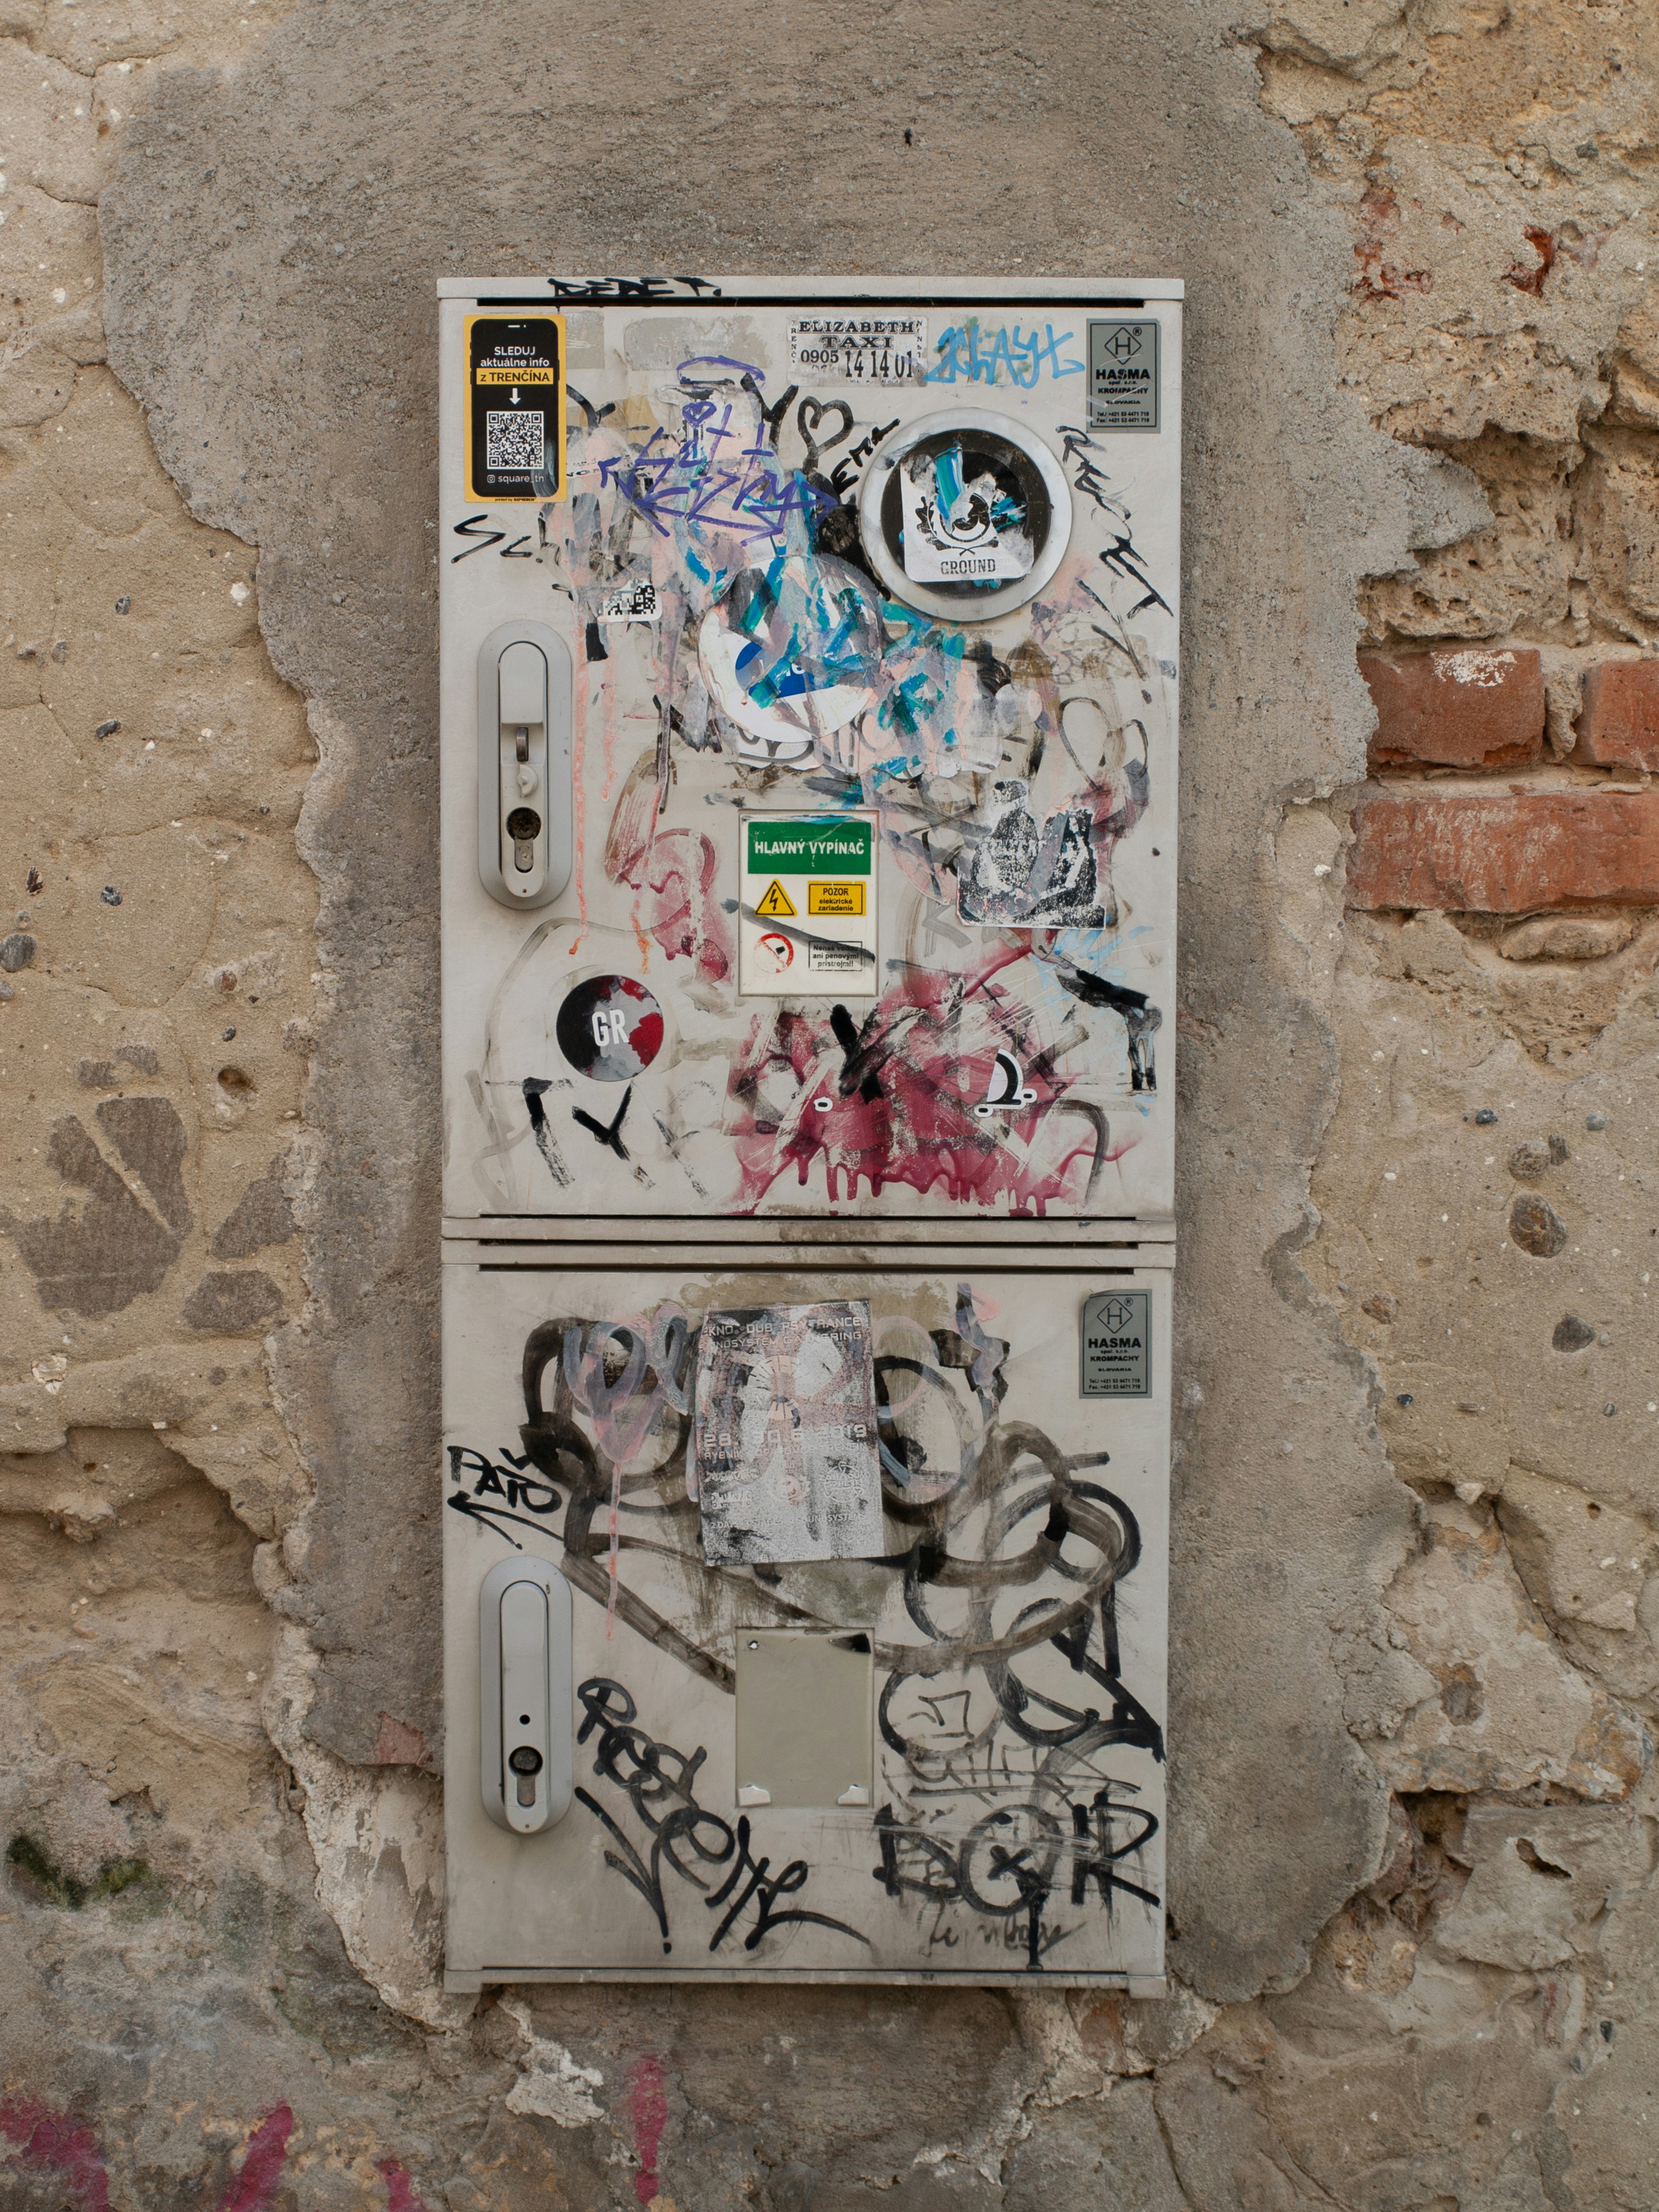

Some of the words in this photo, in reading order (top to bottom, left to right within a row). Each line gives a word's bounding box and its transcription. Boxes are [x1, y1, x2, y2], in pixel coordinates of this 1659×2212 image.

[798, 320, 916, 334] ELIZABETH
[819, 335, 894, 349] TAXI
[494, 346, 536, 356] SLEDUJ
[480, 357, 527, 367] aktuálne
[529, 357, 550, 367] info
[800, 349, 839, 363] 0905
[845, 350, 864, 378] 14
[871, 350, 889, 378] 14
[895, 350, 913, 378] 01
[489, 369, 550, 382] TRENČÍNA
[1096, 369, 1151, 379] HASMA
[940, 558, 996, 575] GROUND
[754, 839, 805, 854] HLAVNÝ
[809, 839, 864, 854] VYPÍNAČ
[823, 887, 849, 896] POZOR
[746, 1322, 773, 1334] DUB
[1088, 1338, 1141, 1348] HASMA
